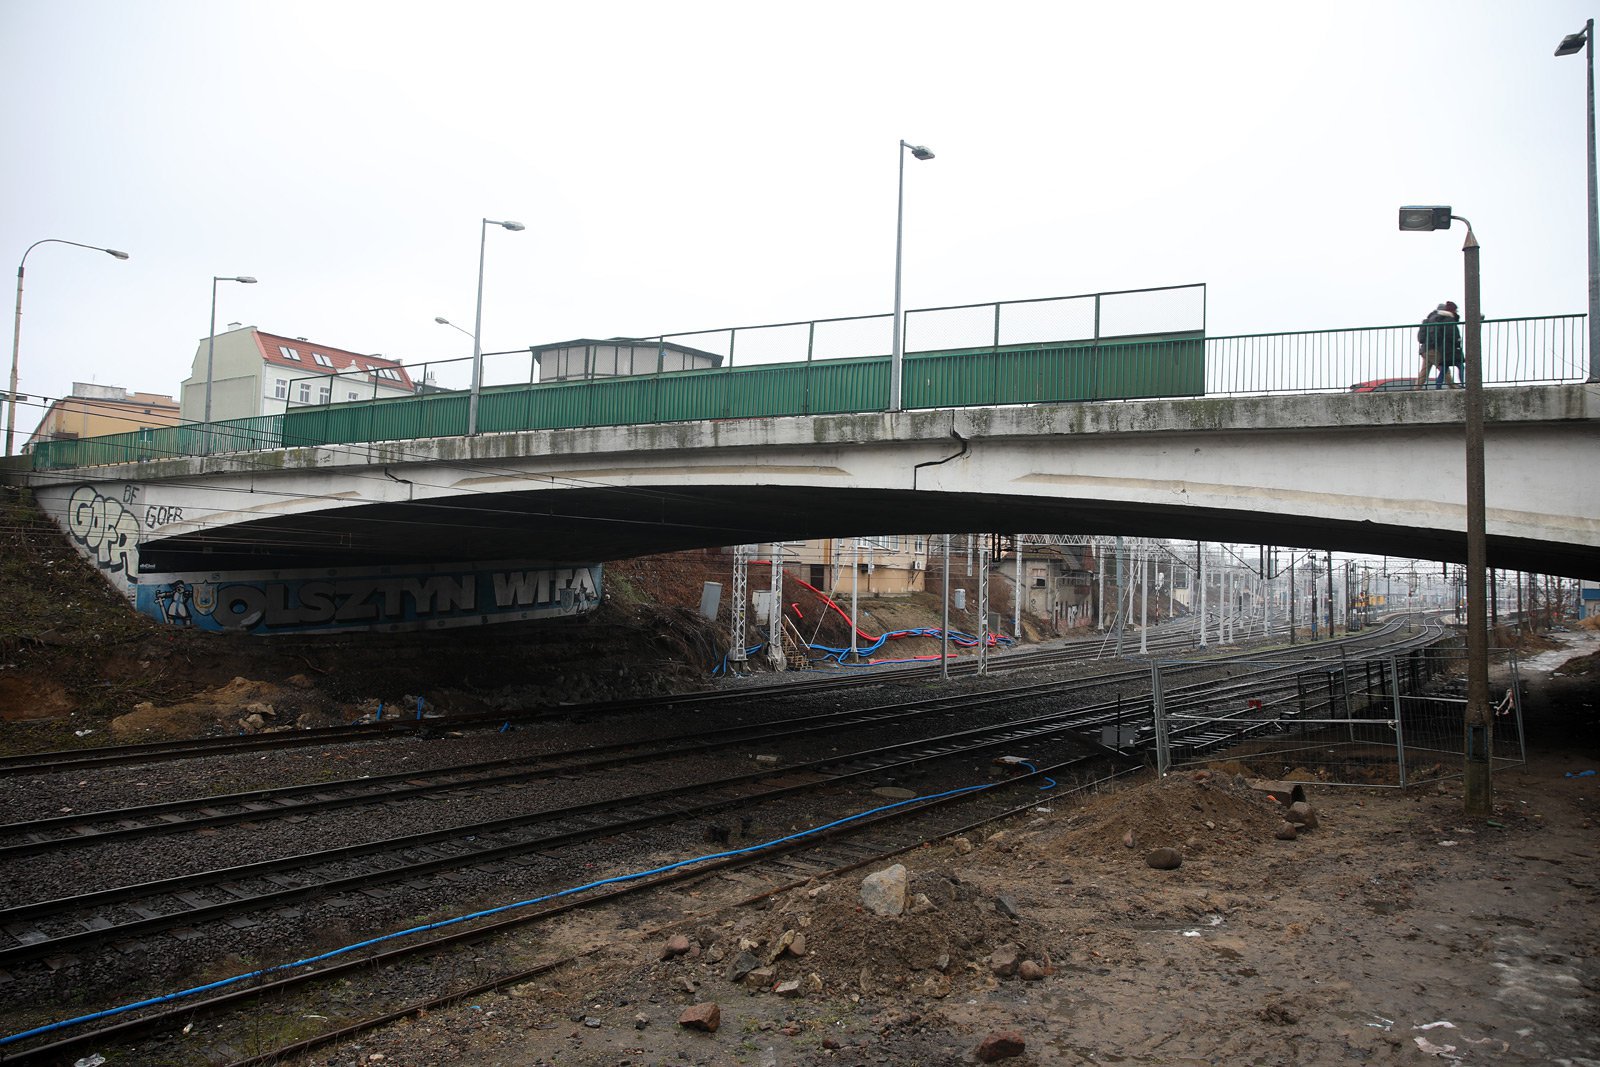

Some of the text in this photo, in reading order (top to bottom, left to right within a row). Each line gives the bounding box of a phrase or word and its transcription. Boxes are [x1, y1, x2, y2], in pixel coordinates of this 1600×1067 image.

[68, 485, 141, 584] GOFR
[212, 568, 598, 629] OLSZTYN WITA
